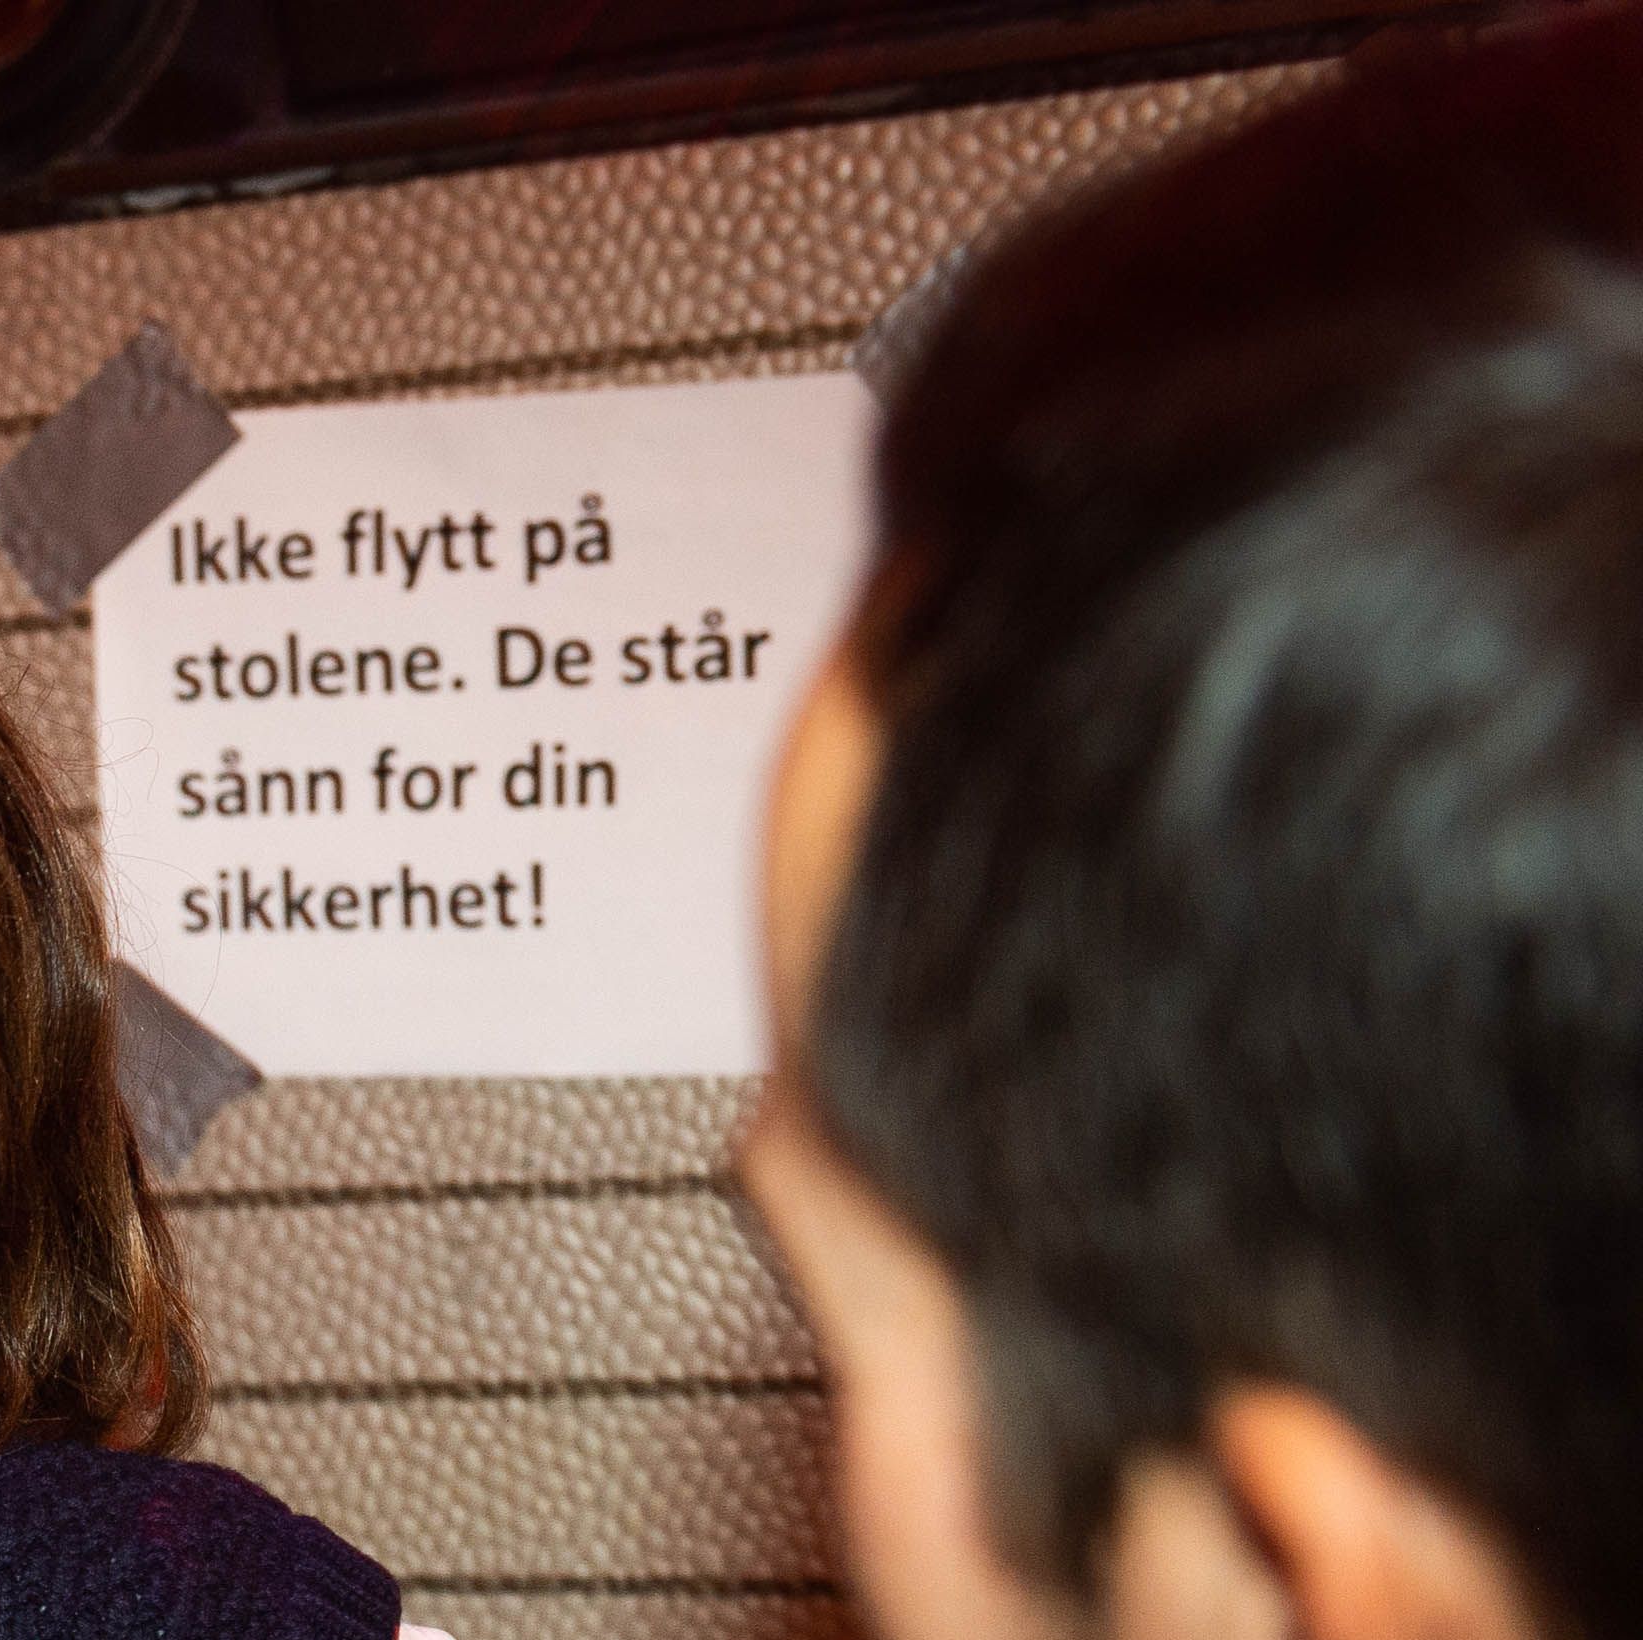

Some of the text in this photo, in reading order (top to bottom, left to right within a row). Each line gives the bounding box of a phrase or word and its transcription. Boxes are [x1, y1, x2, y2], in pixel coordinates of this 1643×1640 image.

[169, 492, 614, 591] Ikke flytt på
[174, 608, 771, 702] stolene. De står
[177, 741, 619, 819] sånn for din
[181, 862, 547, 935] sikkerhet!
